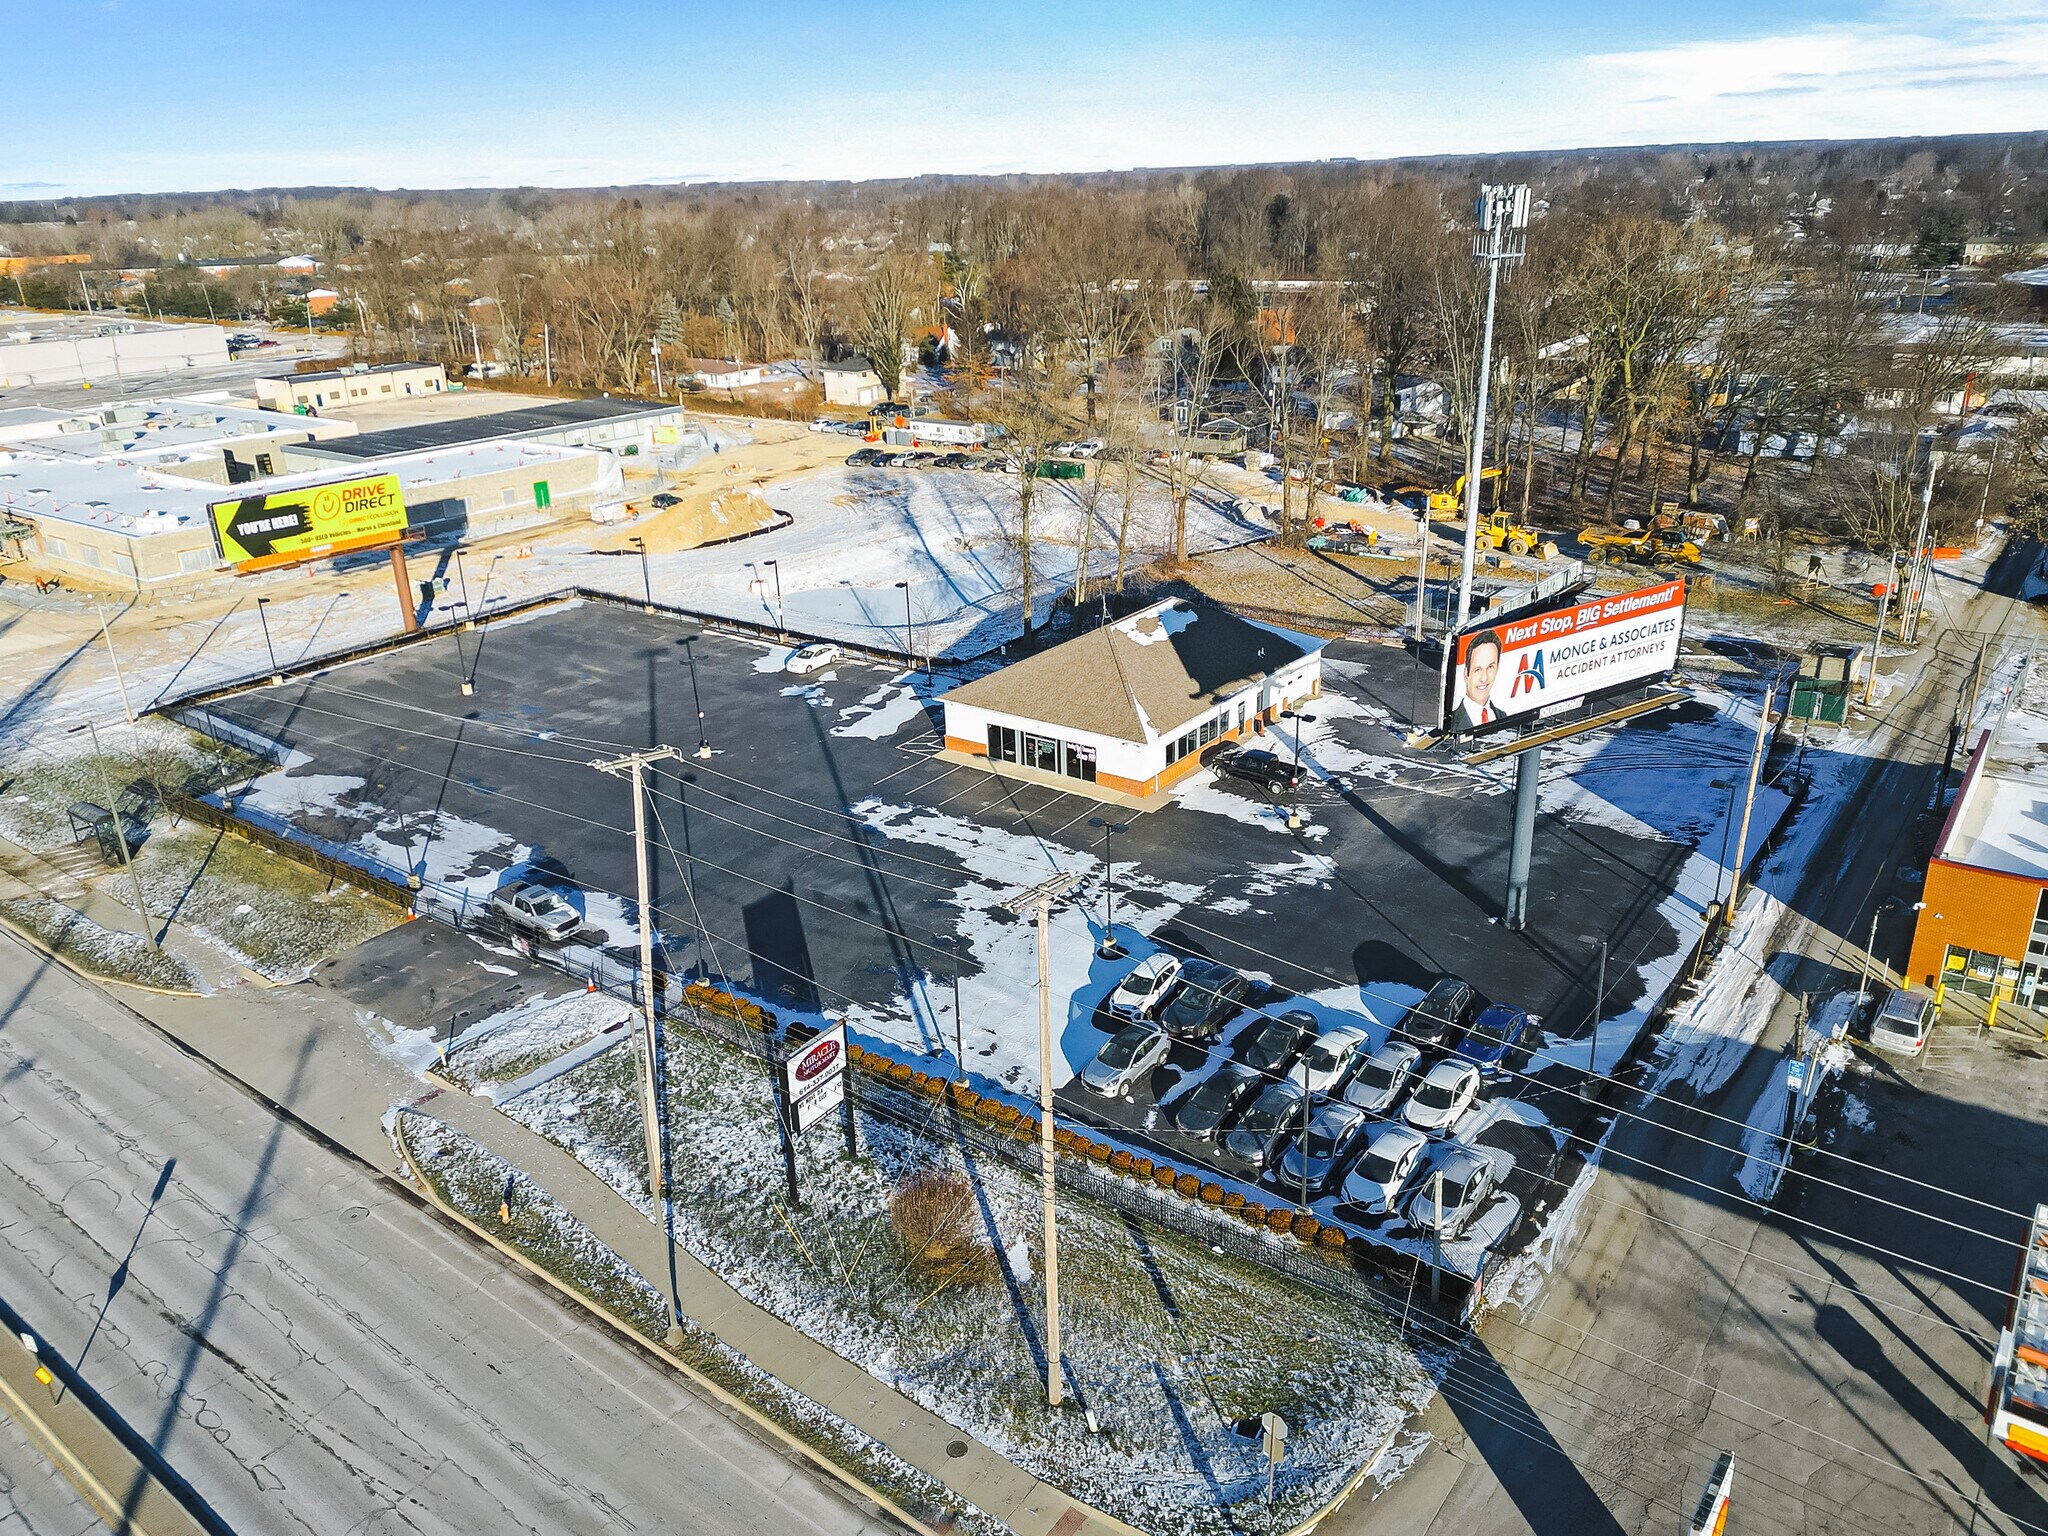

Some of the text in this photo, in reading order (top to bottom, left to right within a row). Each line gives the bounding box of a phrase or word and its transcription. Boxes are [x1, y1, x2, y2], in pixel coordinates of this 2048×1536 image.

[342, 483, 385, 502] DRIVE
[345, 493, 395, 513] DIRECT
[236, 514, 300, 537] YOU'RE HERE!
[1505, 625, 1537, 644] Next
[1540, 615, 1574, 635] Stop,
[1576, 605, 1601, 625] BIG
[1549, 618, 1676, 664] MONGE & ASSOCIATES
[1557, 640, 1666, 680] ACCIDENT ATTORNEYS
[801, 1040, 837, 1071] MIRACLE
[803, 1050, 836, 1077] MOTOR MART
